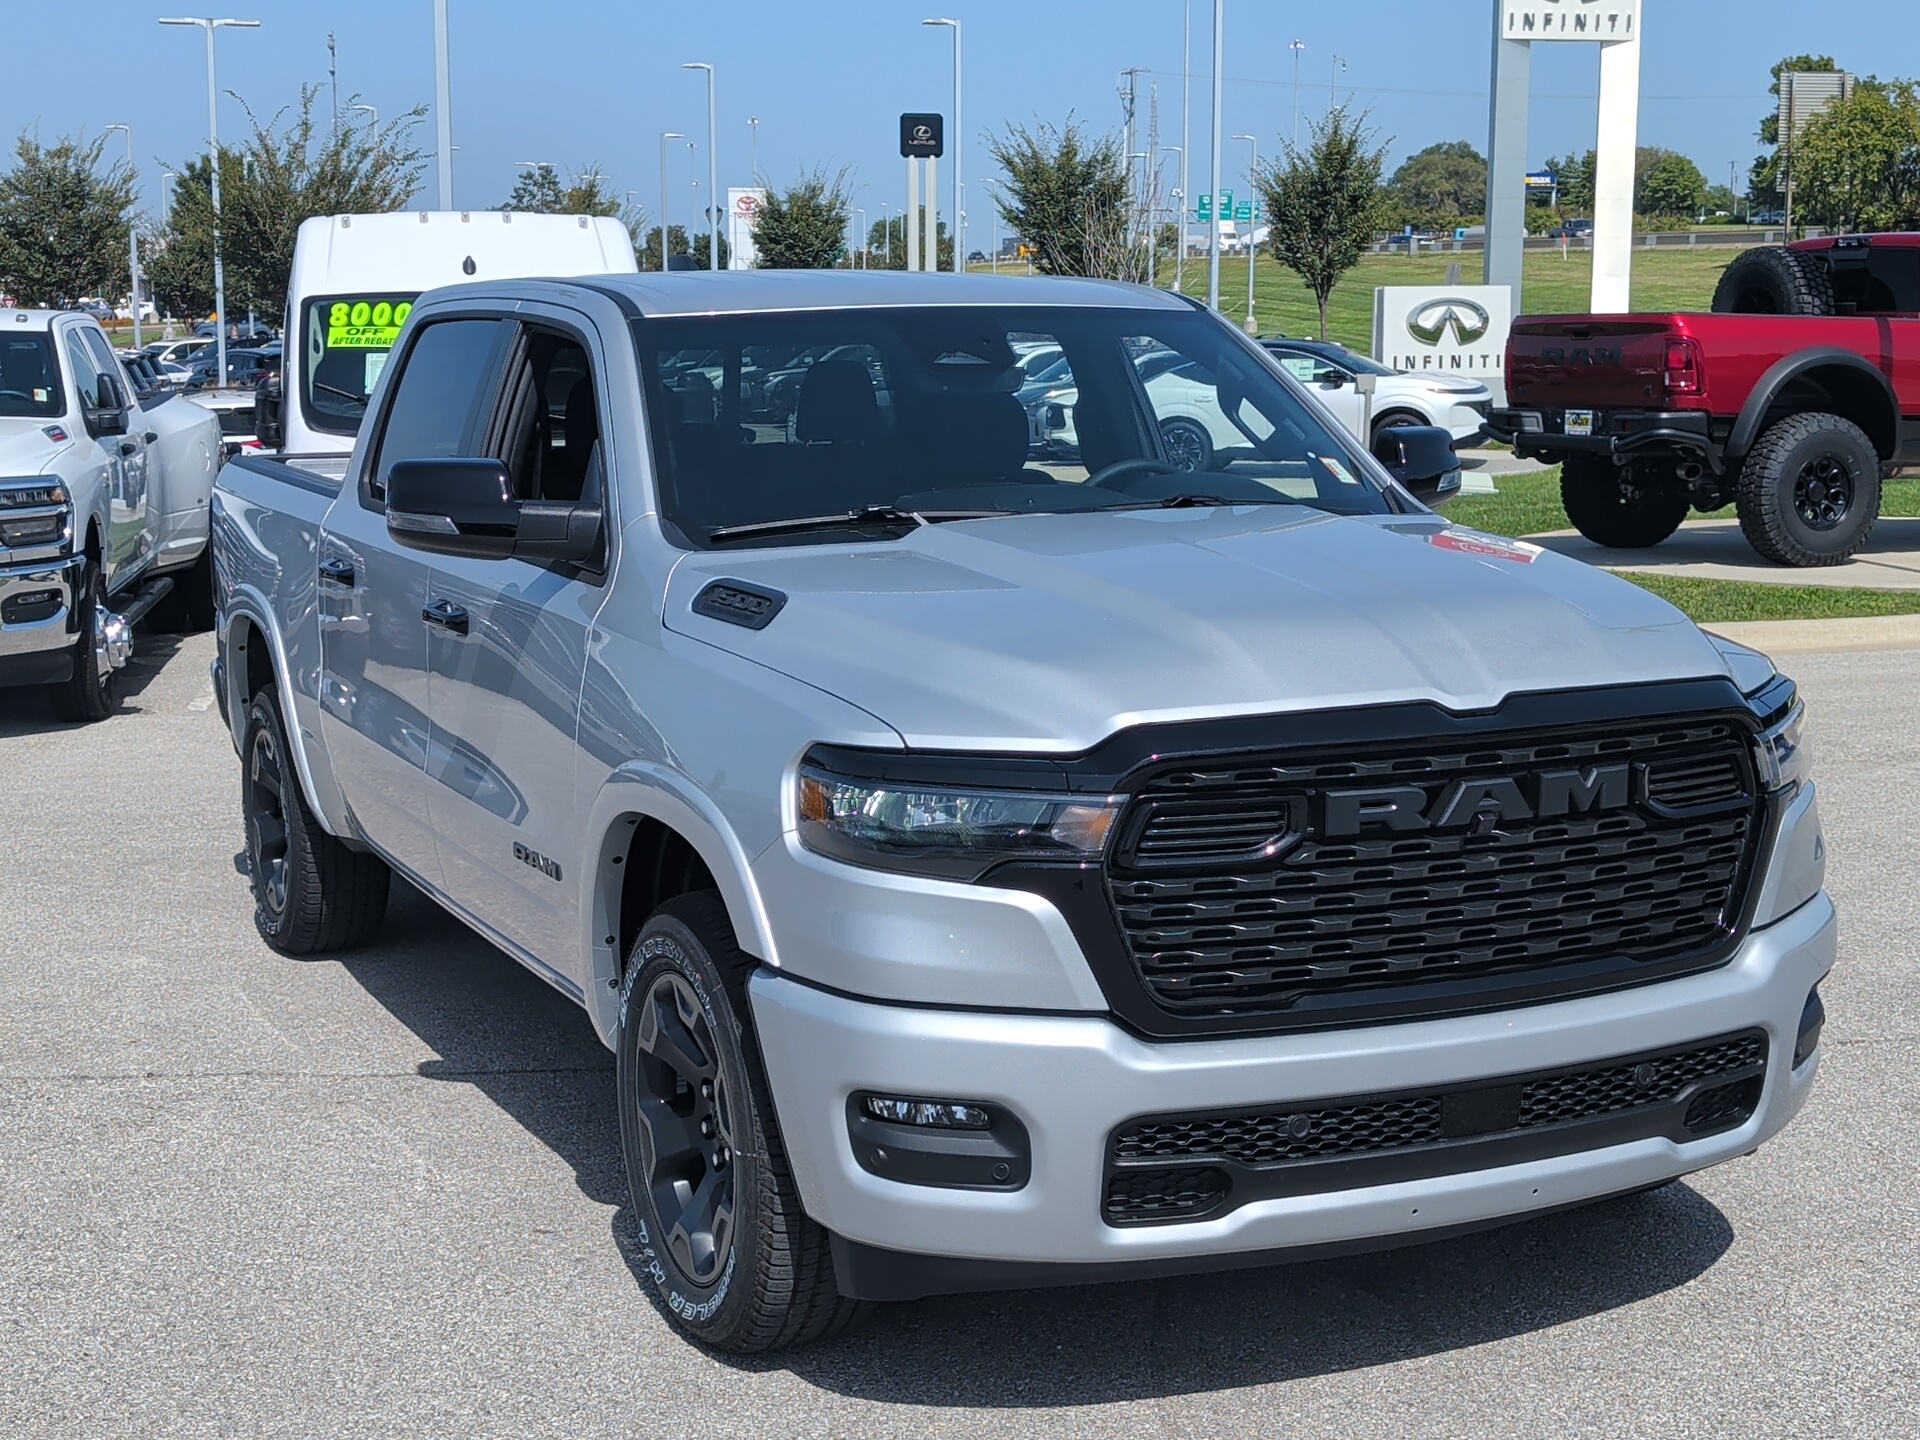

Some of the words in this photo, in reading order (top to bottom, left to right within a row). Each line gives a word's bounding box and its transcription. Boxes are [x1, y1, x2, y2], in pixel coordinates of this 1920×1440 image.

[1508, 12, 1632, 33] INFINITI
[329, 302, 412, 326] 8000
[332, 337, 363, 346] AFTER
[363, 337, 395, 346] REBAT
[345, 327, 387, 336] OFF
[1393, 354, 1501, 370] INFINITI
[1540, 347, 1623, 366] RAM
[1325, 763, 1630, 837] RAM
[513, 841, 563, 882] RAM
